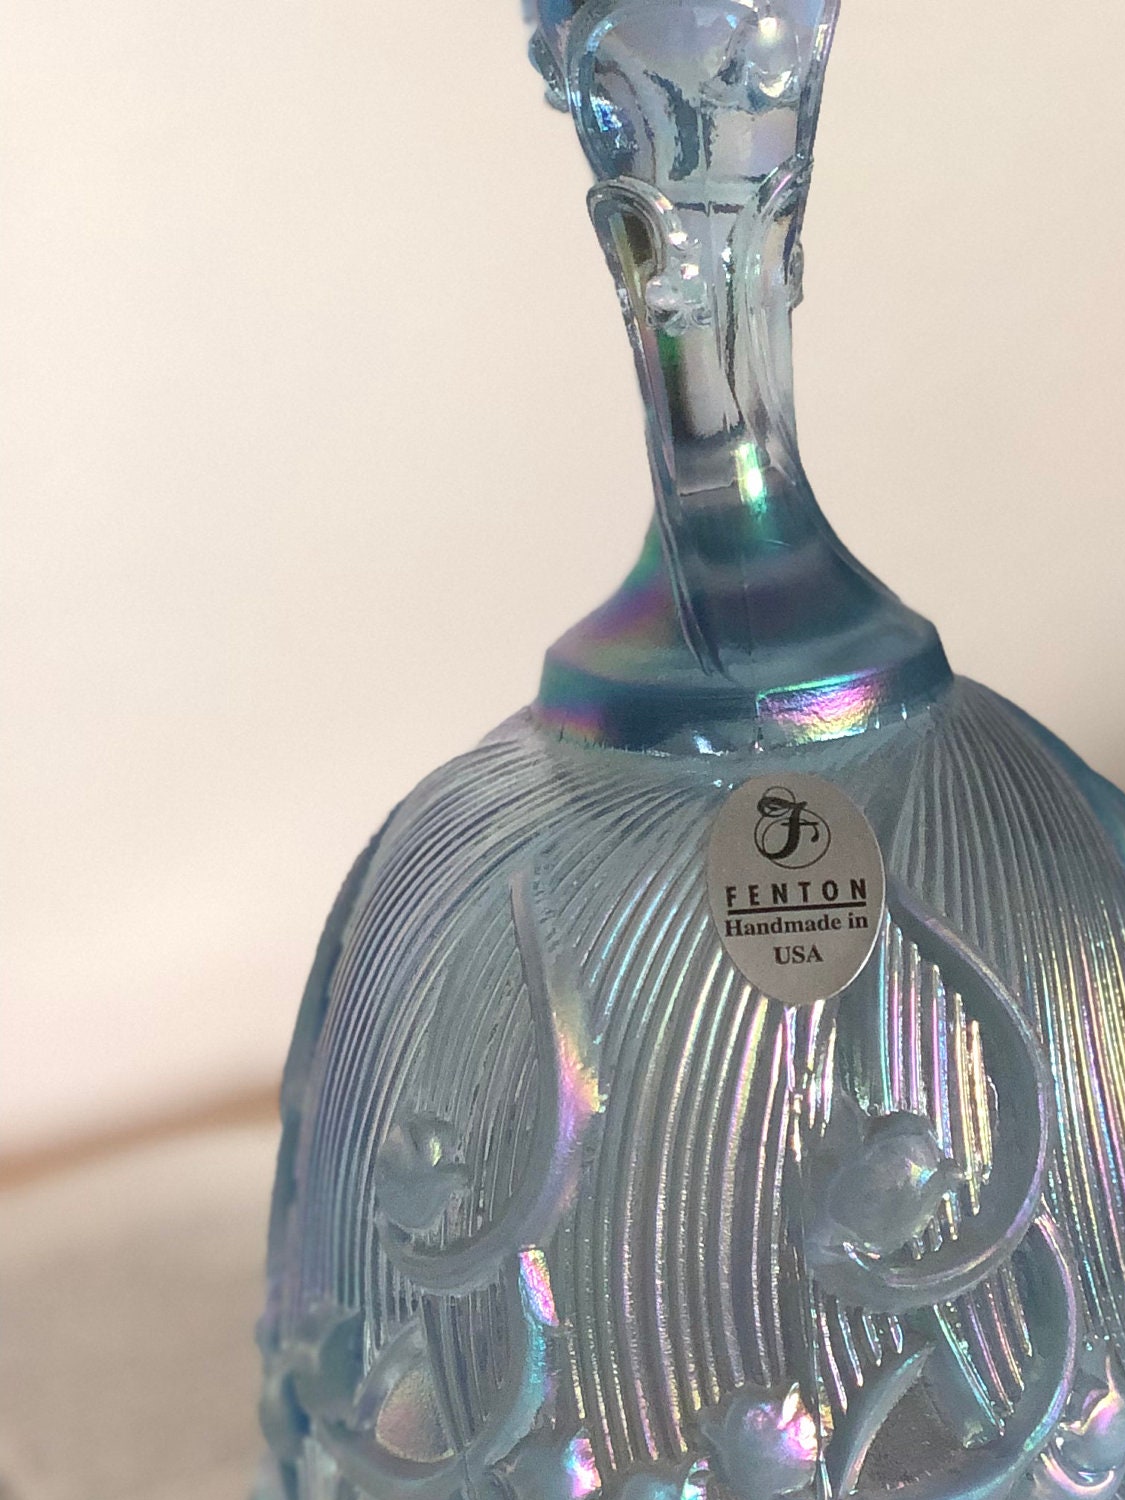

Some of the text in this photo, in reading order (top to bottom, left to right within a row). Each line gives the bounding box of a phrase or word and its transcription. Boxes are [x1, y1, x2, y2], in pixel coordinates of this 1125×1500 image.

[725, 879, 867, 907] FENTON
[724, 912, 868, 937] Handmade in
[774, 945, 824, 965] USA
